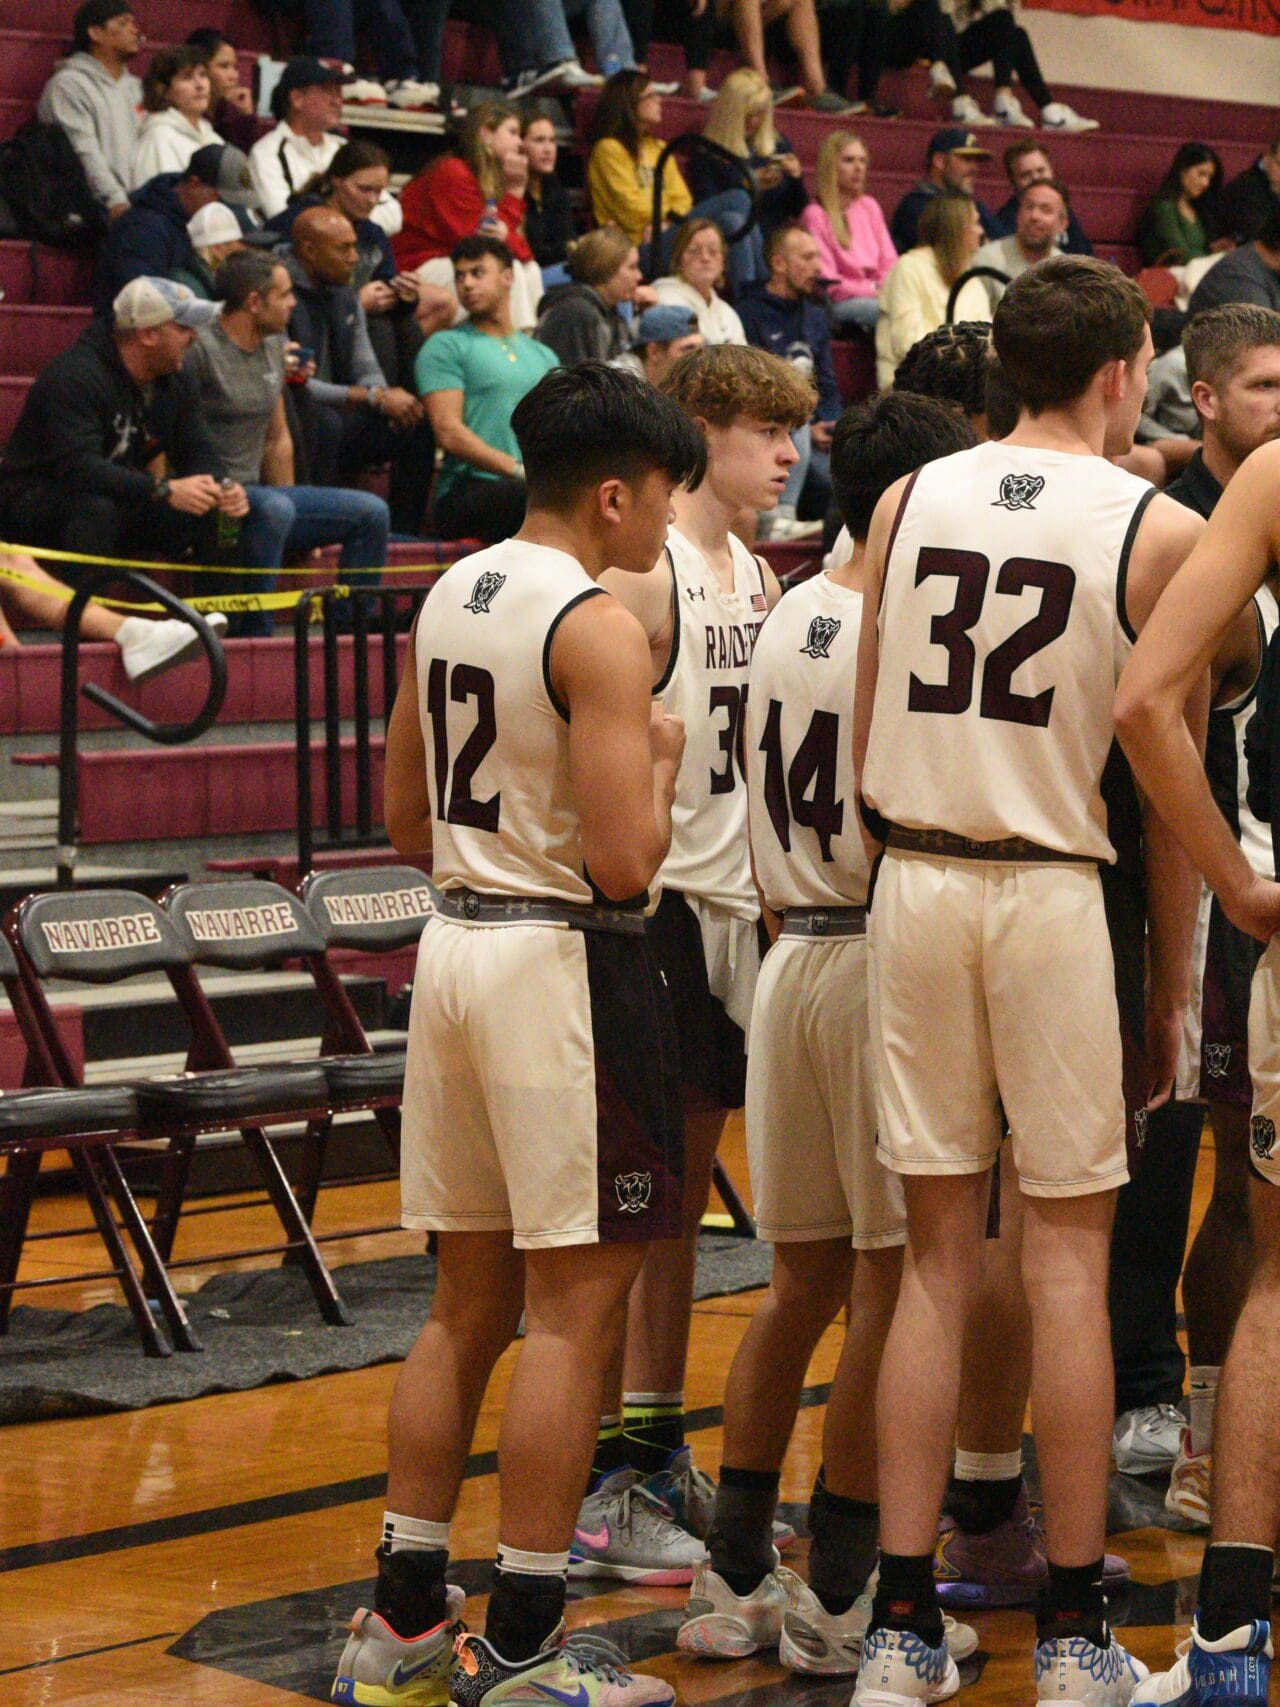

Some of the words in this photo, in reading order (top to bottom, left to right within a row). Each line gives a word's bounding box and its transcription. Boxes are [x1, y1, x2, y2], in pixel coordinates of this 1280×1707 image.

[907, 546, 1077, 728] 32
[426, 657, 501, 834] 12
[758, 698, 846, 863] 14
[41, 912, 162, 953] NAVARRE
[185, 902, 299, 940] NAVARRE
[323, 886, 436, 925] NAVARRE
